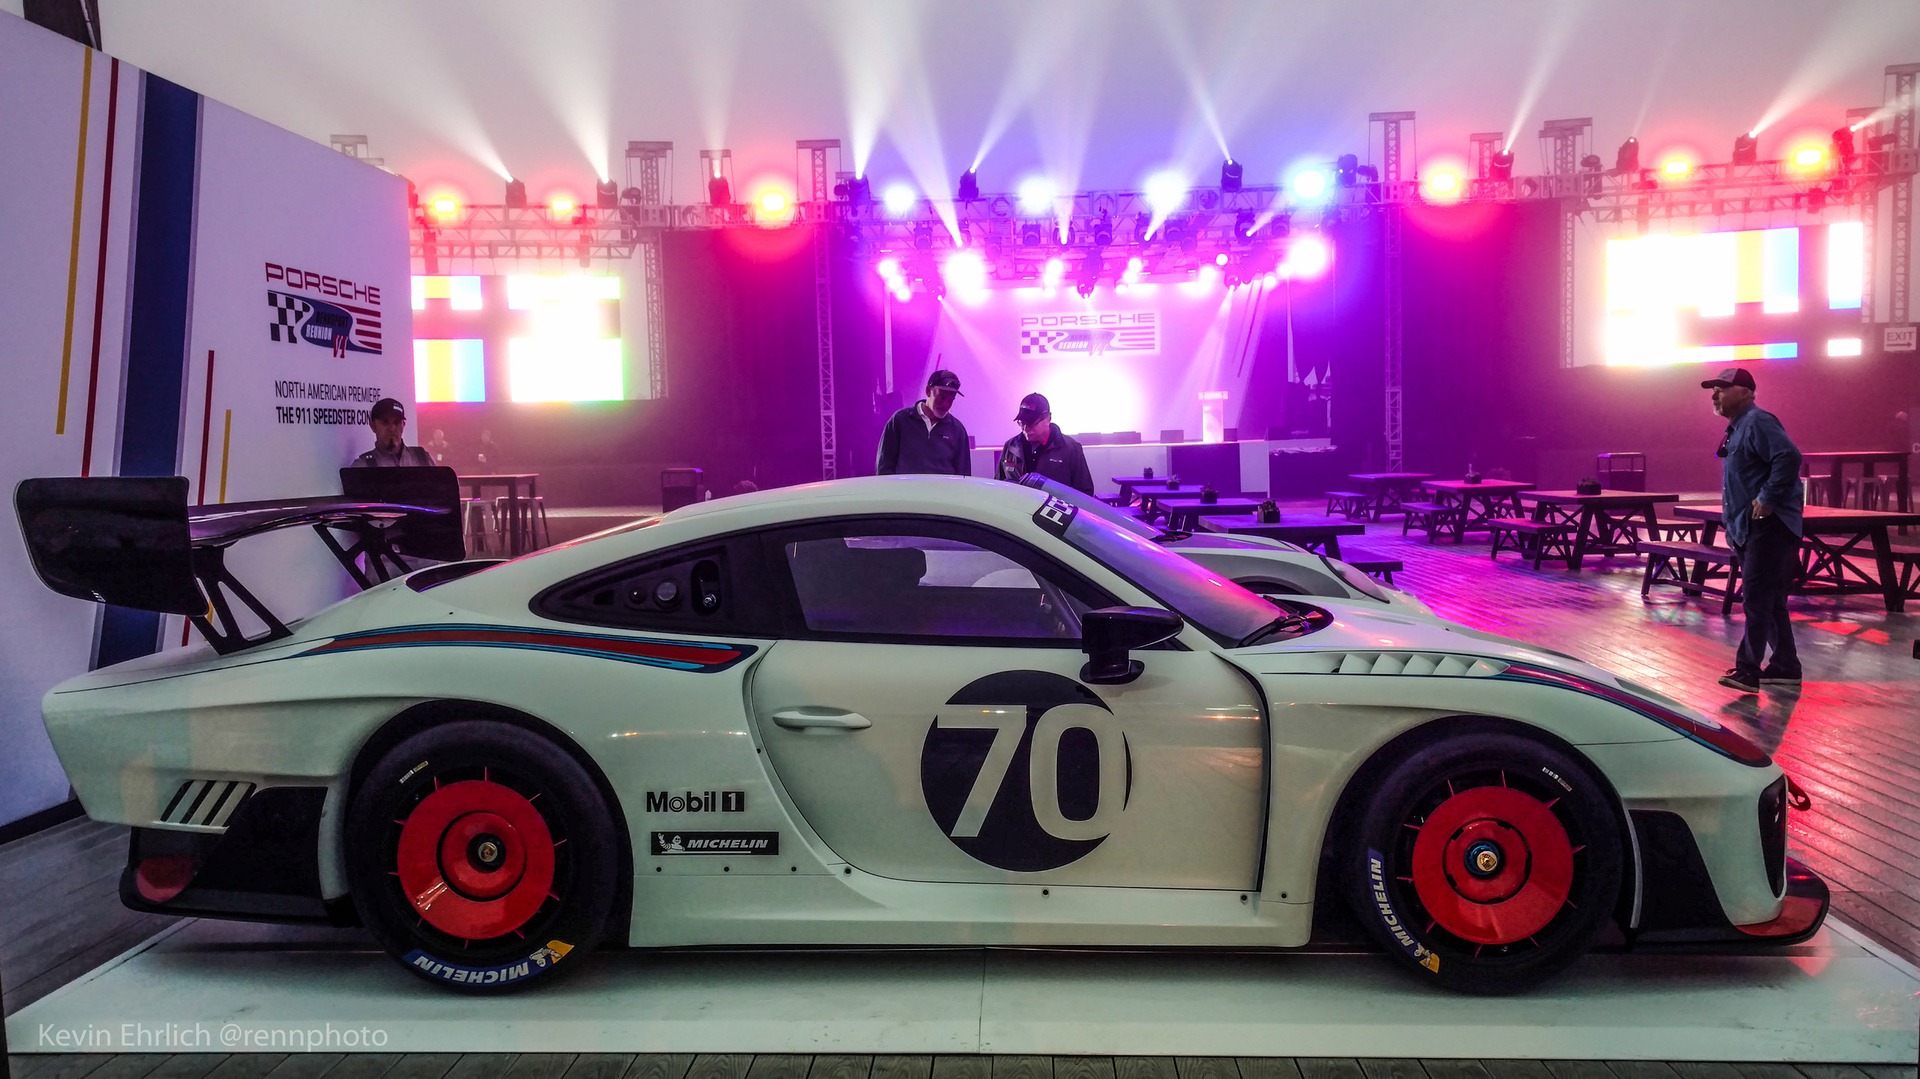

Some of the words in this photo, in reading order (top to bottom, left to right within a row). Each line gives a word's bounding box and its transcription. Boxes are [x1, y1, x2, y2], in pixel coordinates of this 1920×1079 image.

[265, 262, 381, 306] PORSCHE
[1021, 313, 1155, 327] PORSCHE
[305, 324, 333, 341] REUNION
[1886, 331, 1914, 342] EXIT
[333, 335, 348, 358] VI
[1058, 341, 1089, 350] REUNION
[275, 380, 306, 399] NORTH
[307, 382, 347, 402] AMERICAN
[348, 385, 381, 403] PREMIERE
[276, 406, 295, 424] THE
[295, 407, 312, 425] 911
[313, 408, 356, 426] SPEEDSTER
[356, 410, 372, 426] CON
[937, 703, 1127, 841] 70
[646, 791, 716, 812] Mobil
[687, 839, 769, 849] MICHELIN
[1370, 857, 1415, 947] MICHELIN
[413, 955, 530, 984] MICHELIN
